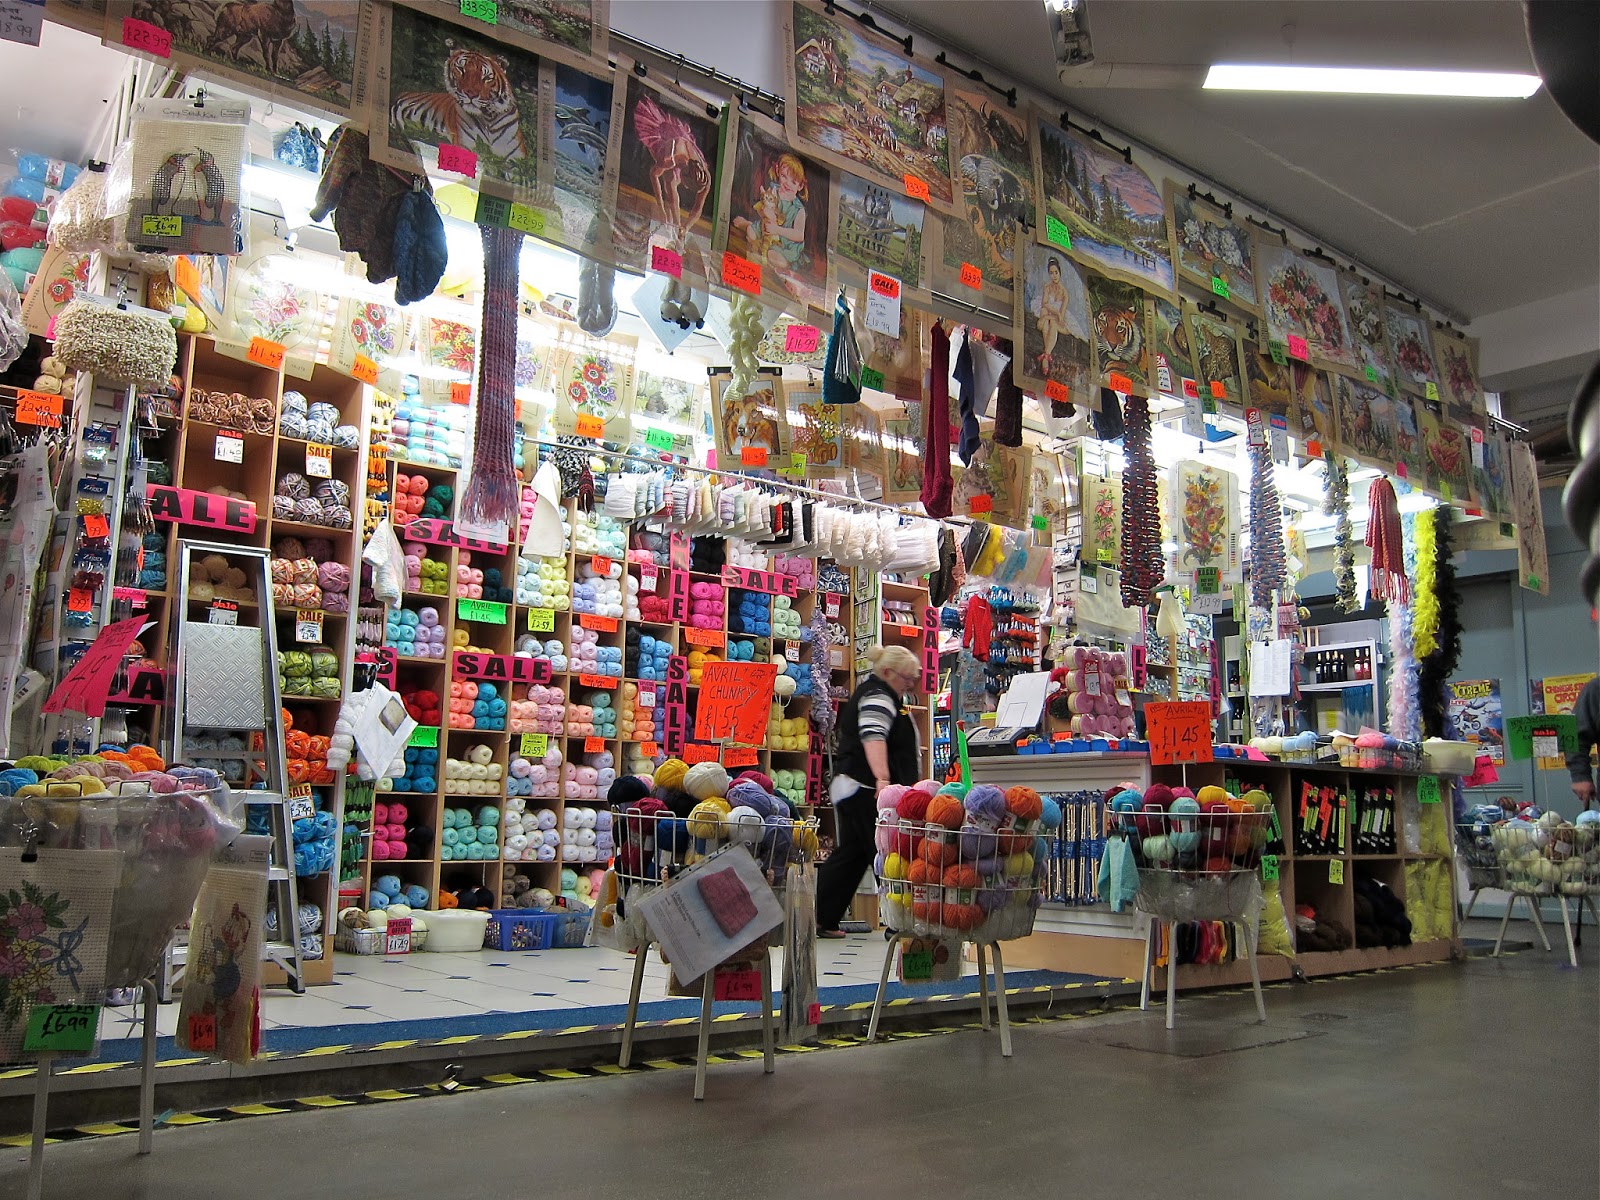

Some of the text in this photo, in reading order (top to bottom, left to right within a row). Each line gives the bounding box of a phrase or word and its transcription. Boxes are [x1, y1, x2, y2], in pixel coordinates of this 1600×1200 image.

[486, 214, 500, 223] FREE
[874, 278, 895, 291] SALE
[249, 342, 284, 361] £11.49
[218, 430, 243, 439] sale
[308, 445, 331, 459] SALE
[151, 488, 250, 528] ALE
[409, 519, 508, 554] SA
[723, 566, 796, 595] SALE
[470, 600, 492, 610] AVRIL
[299, 610, 323, 622] SALE
[925, 608, 938, 693] SALE
[455, 654, 550, 681] SALE
[703, 666, 742, 683] AVRIL
[709, 684, 757, 701] CHUNKY
[667, 657, 685, 753] SALE
[1165, 704, 1194, 717] AVRIL
[702, 706, 740, 733] £1.55
[1161, 724, 1200, 750] £1.45
[807, 734, 822, 803] ALE
[290, 785, 311, 800] SALE
[389, 920, 411, 930] SPECIAL
[391, 928, 407, 937] OFFER
